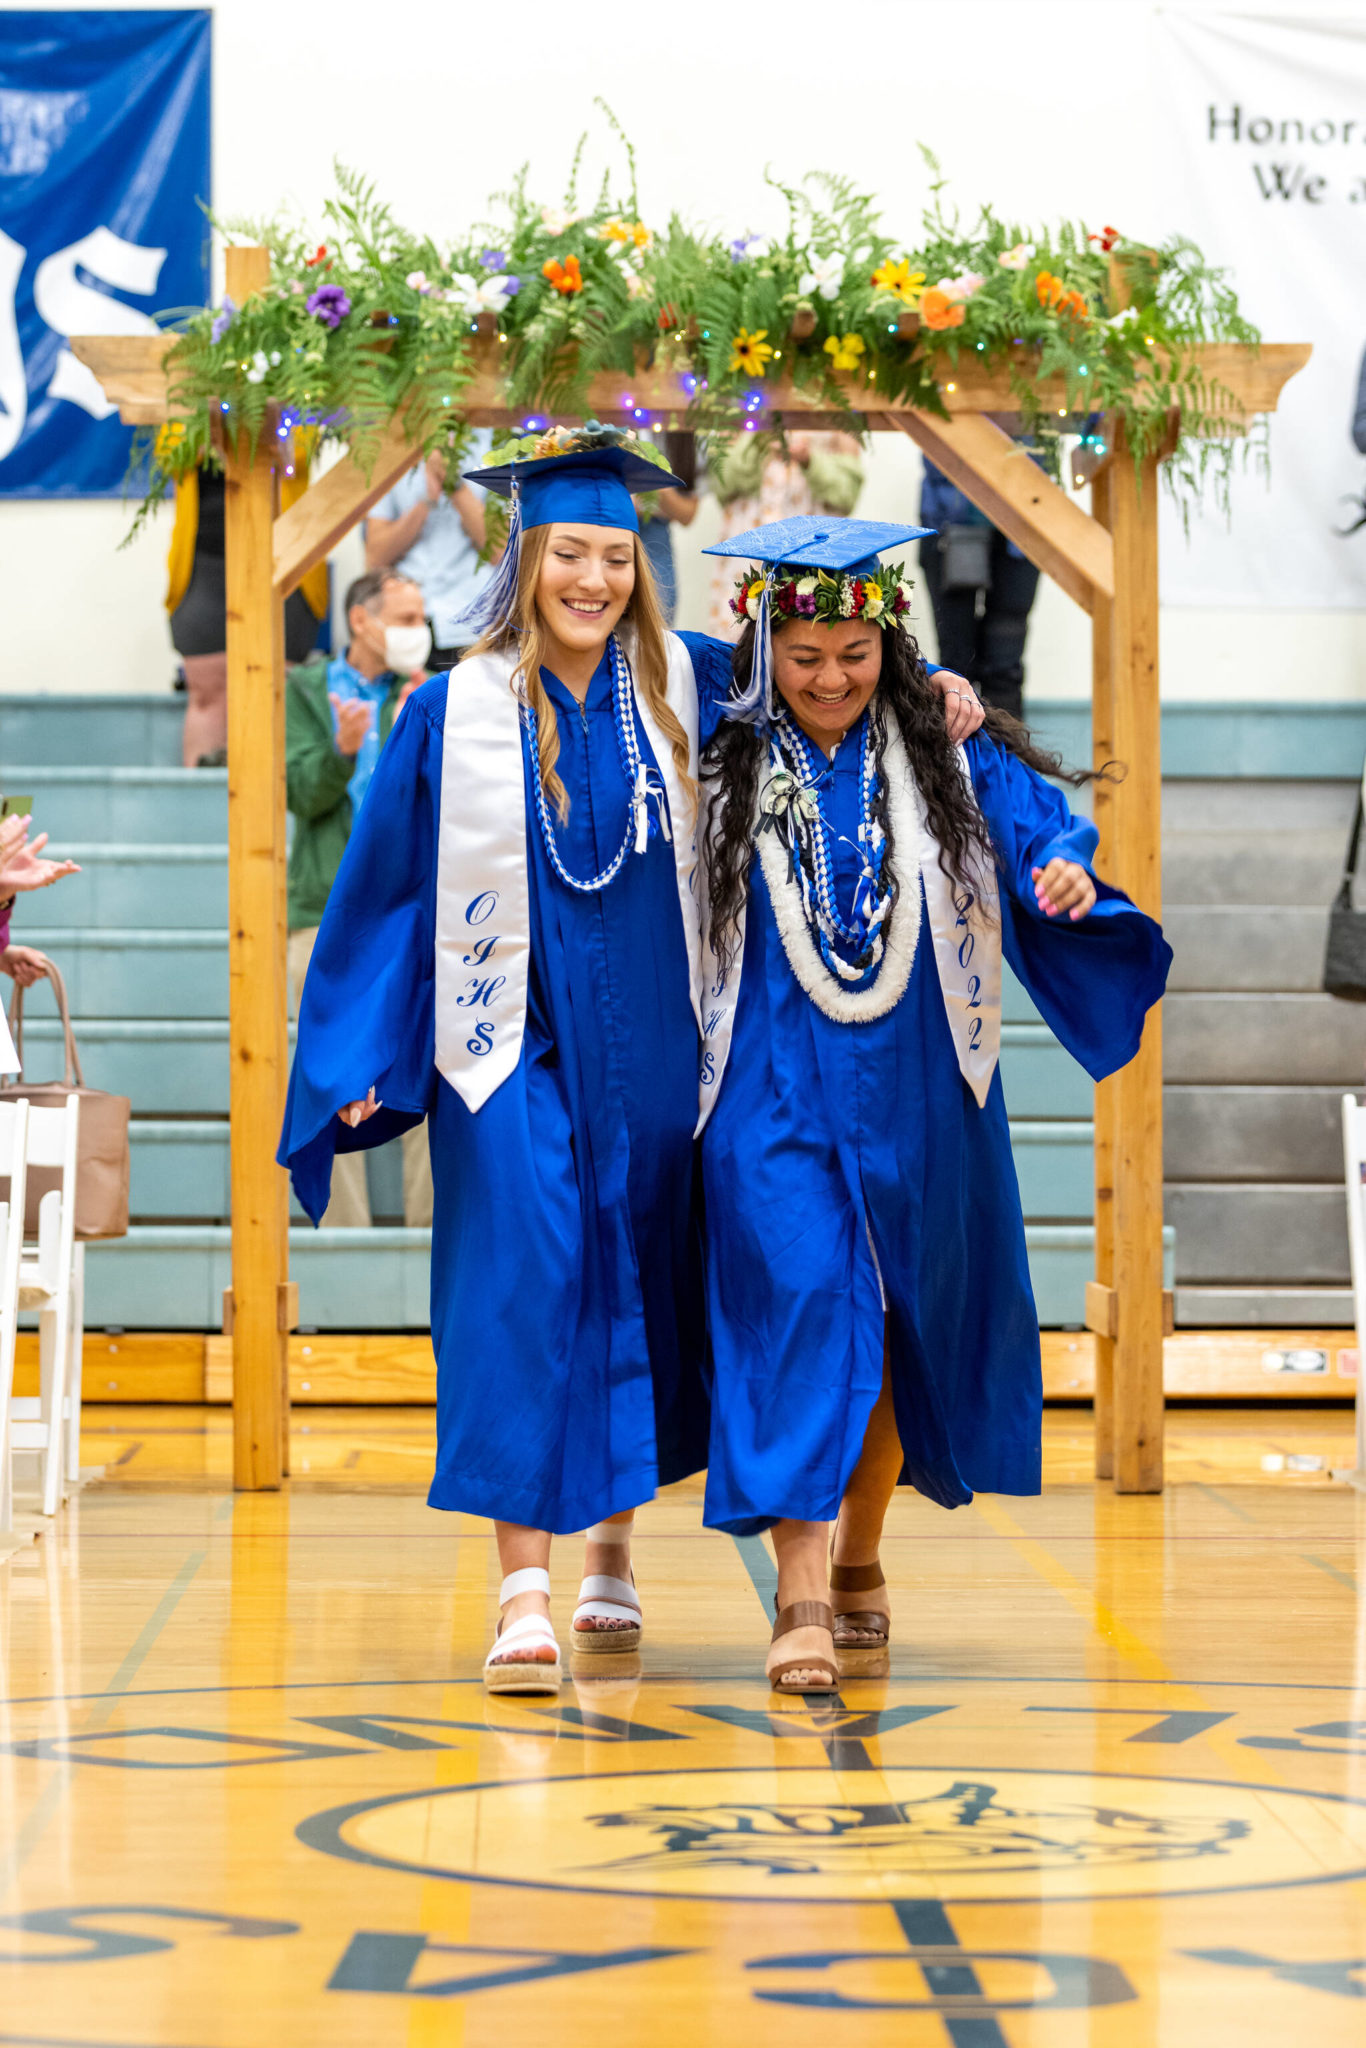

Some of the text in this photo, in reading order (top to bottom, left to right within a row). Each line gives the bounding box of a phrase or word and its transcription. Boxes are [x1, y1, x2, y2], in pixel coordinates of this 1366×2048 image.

[1207, 103, 1366, 145] Honor
[1252, 163, 1326, 204] We
[955, 892, 983, 1054] 2022
